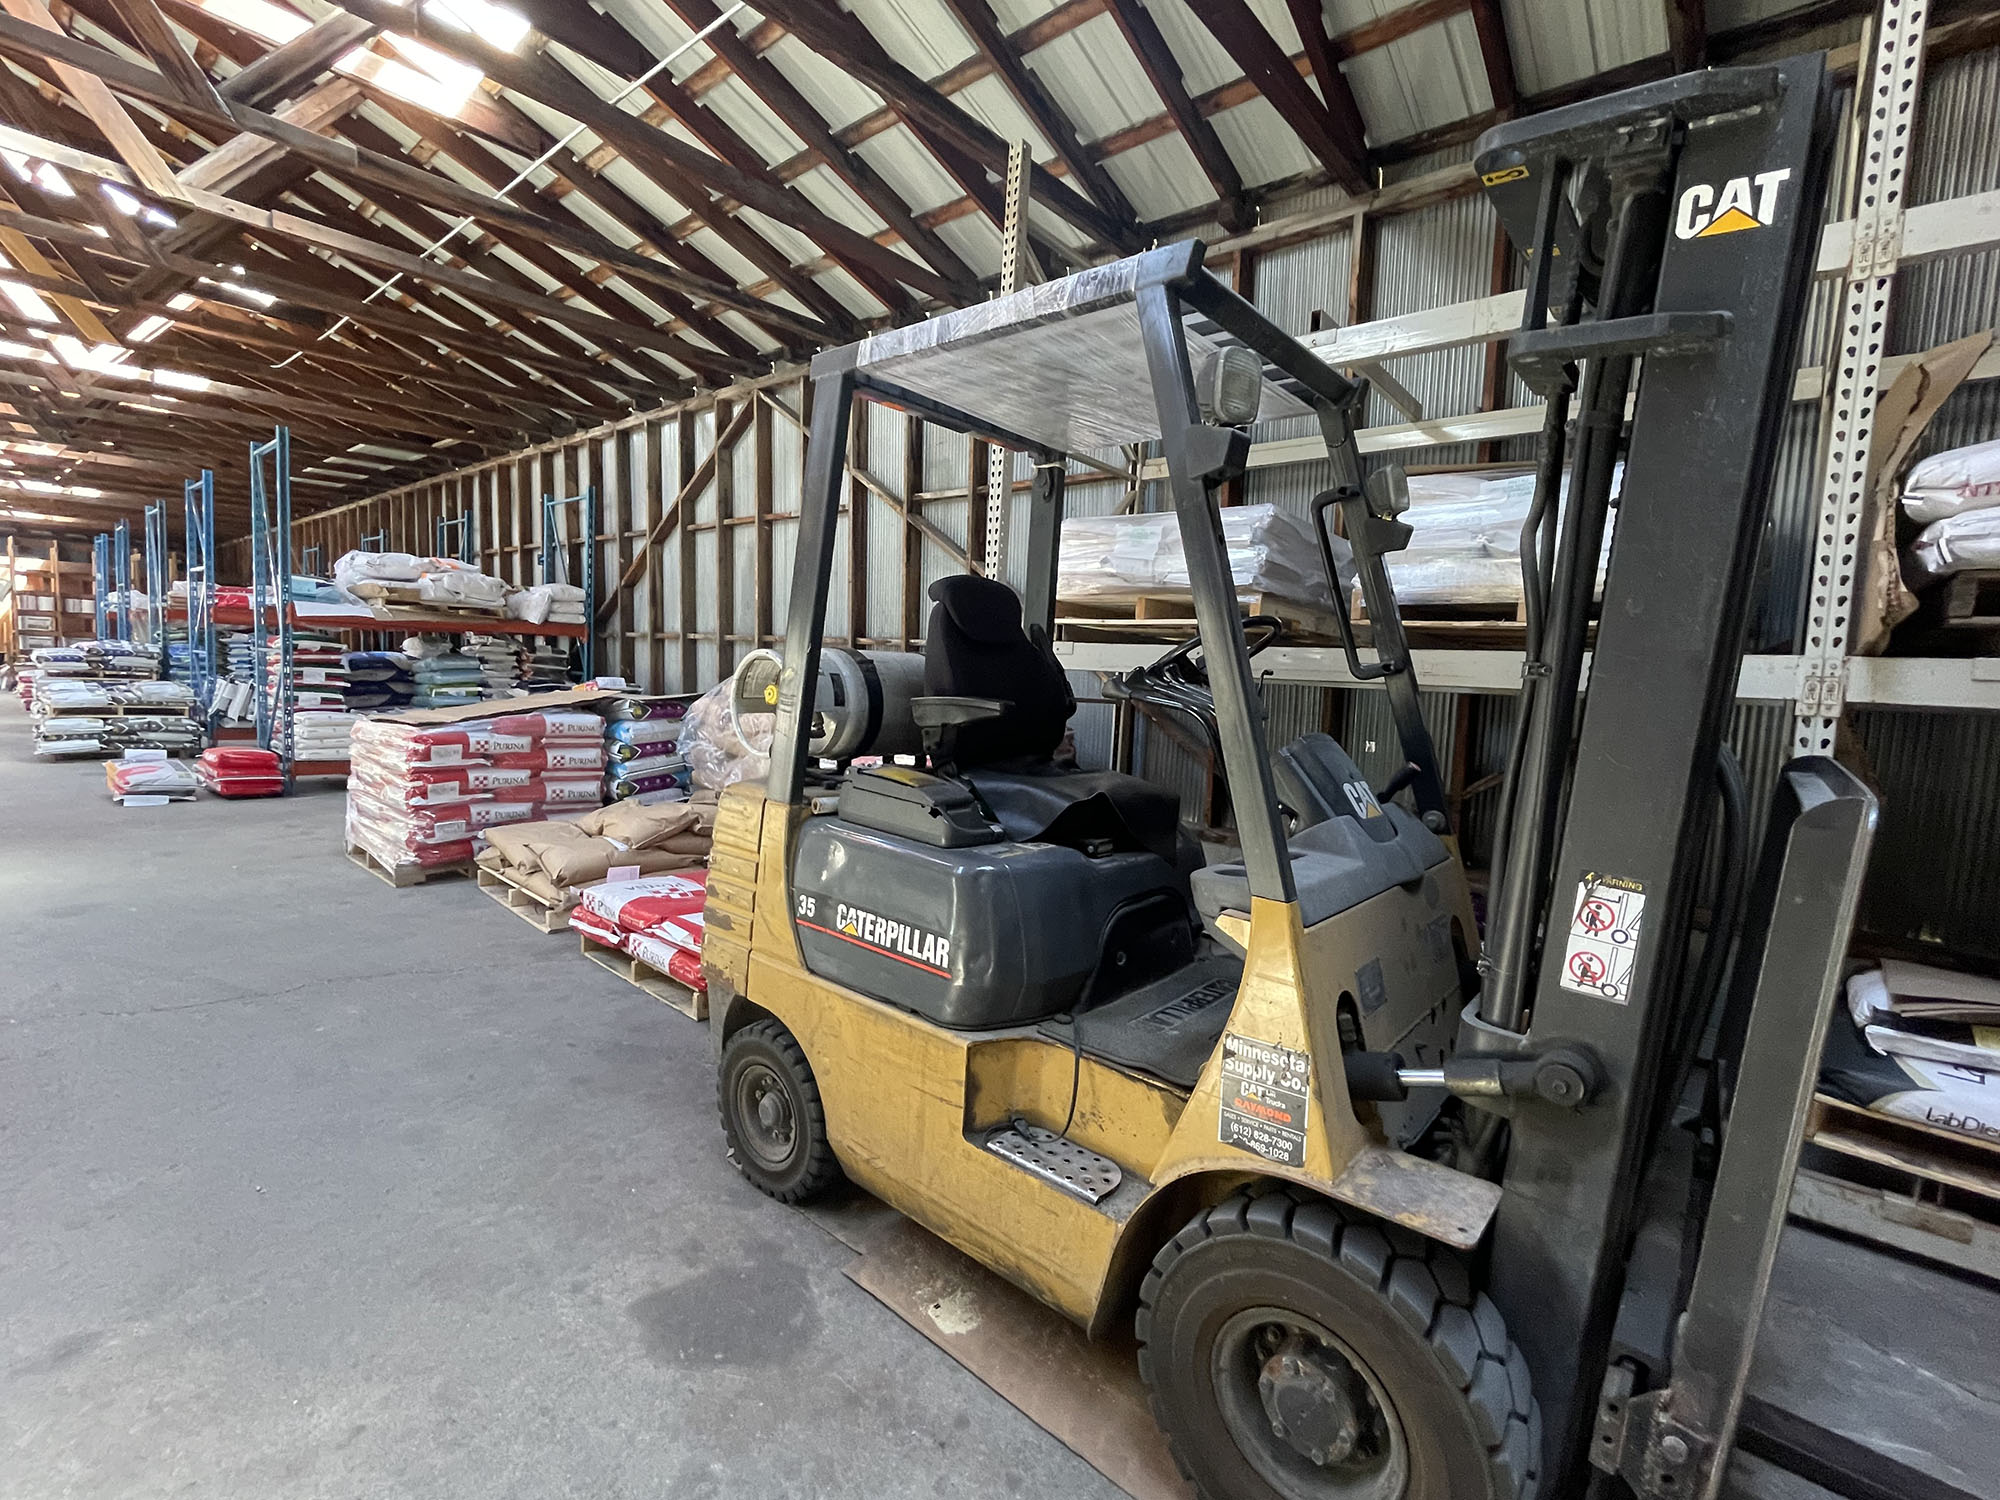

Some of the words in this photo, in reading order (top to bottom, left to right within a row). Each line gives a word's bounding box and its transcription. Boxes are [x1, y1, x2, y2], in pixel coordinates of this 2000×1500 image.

[1674, 168, 1791, 240] CAT
[567, 724, 595, 732] PURINA
[493, 741, 525, 750] PURINA
[568, 757, 597, 765] PURINA
[492, 777, 525, 785] PURINA
[1343, 781, 1384, 819] CAT
[495, 811, 527, 820] PURINA
[798, 894, 816, 918] 35
[836, 903, 950, 968] CATERPILLAR
[1226, 1036, 1306, 1073] Minnesota
[1225, 1057, 1276, 1085] Supply
[1280, 1072, 1306, 1092] Co.
[1240, 1081, 1264, 1101] CAT
[1234, 1098, 1292, 1123] RAYMOND
[1925, 1106, 2000, 1138] LabDie
[1230, 1122, 1252, 1138] (612)
